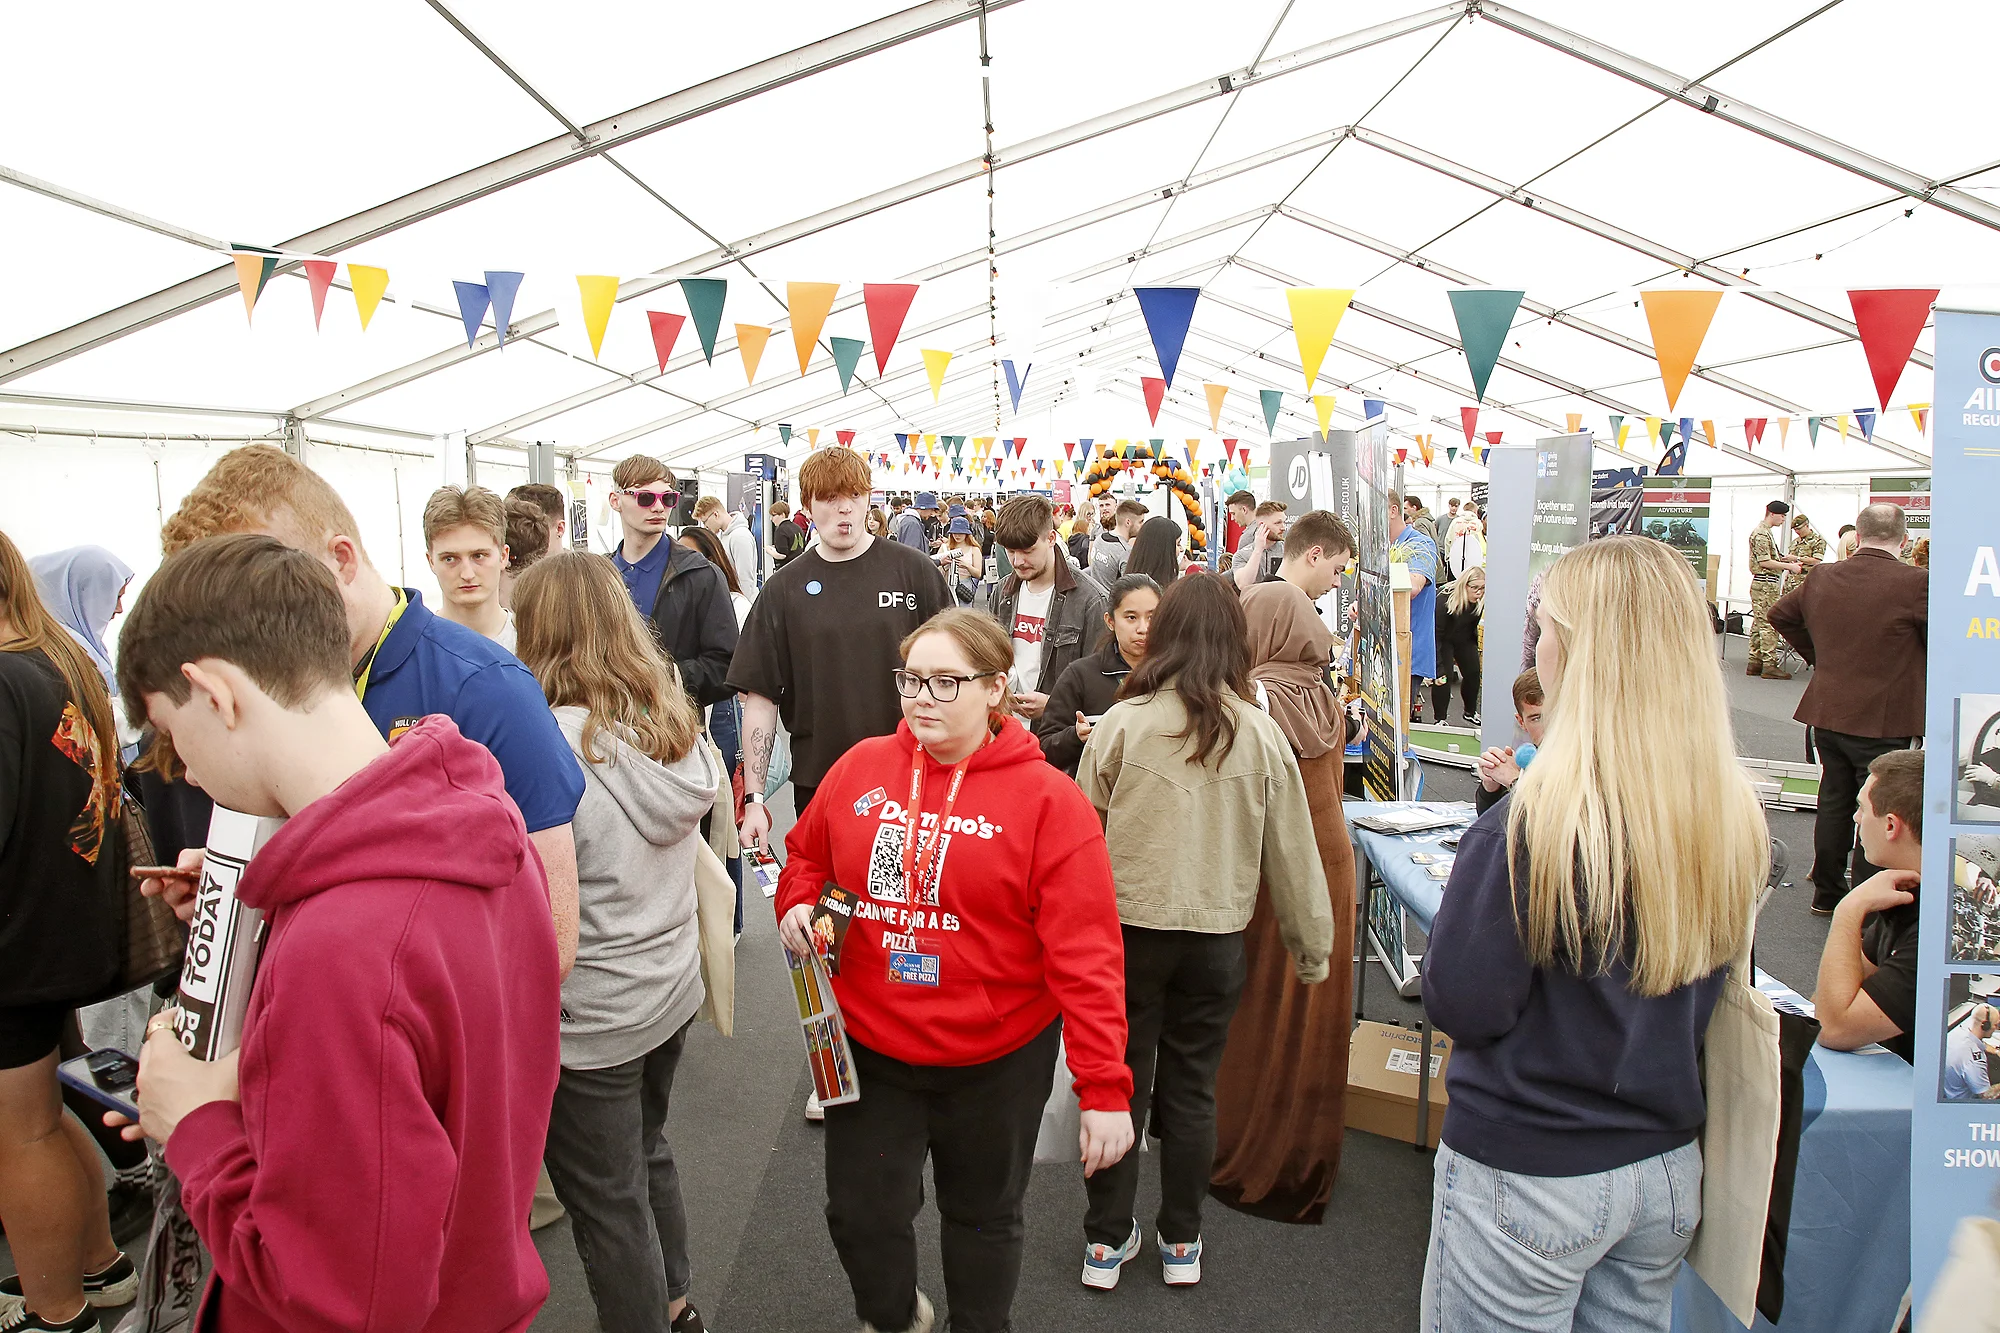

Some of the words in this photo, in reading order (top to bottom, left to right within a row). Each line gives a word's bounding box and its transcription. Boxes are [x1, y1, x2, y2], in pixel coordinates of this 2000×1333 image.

[395, 719, 409, 727] HULL
[911, 768, 920, 800] Domino's
[947, 770, 963, 802] Domino's
[879, 800, 994, 840] Domno's
[824, 897, 852, 917] KEBABS
[853, 900, 880, 921] CAN
[879, 906, 898, 925] ME
[928, 911, 939, 930] A
[942, 912, 960, 932] £5
[190, 874, 223, 985] TODAY
[881, 930, 917, 953] PIZZA
[903, 971, 918, 981] FREE
[918, 973, 936, 983] PIZZA
